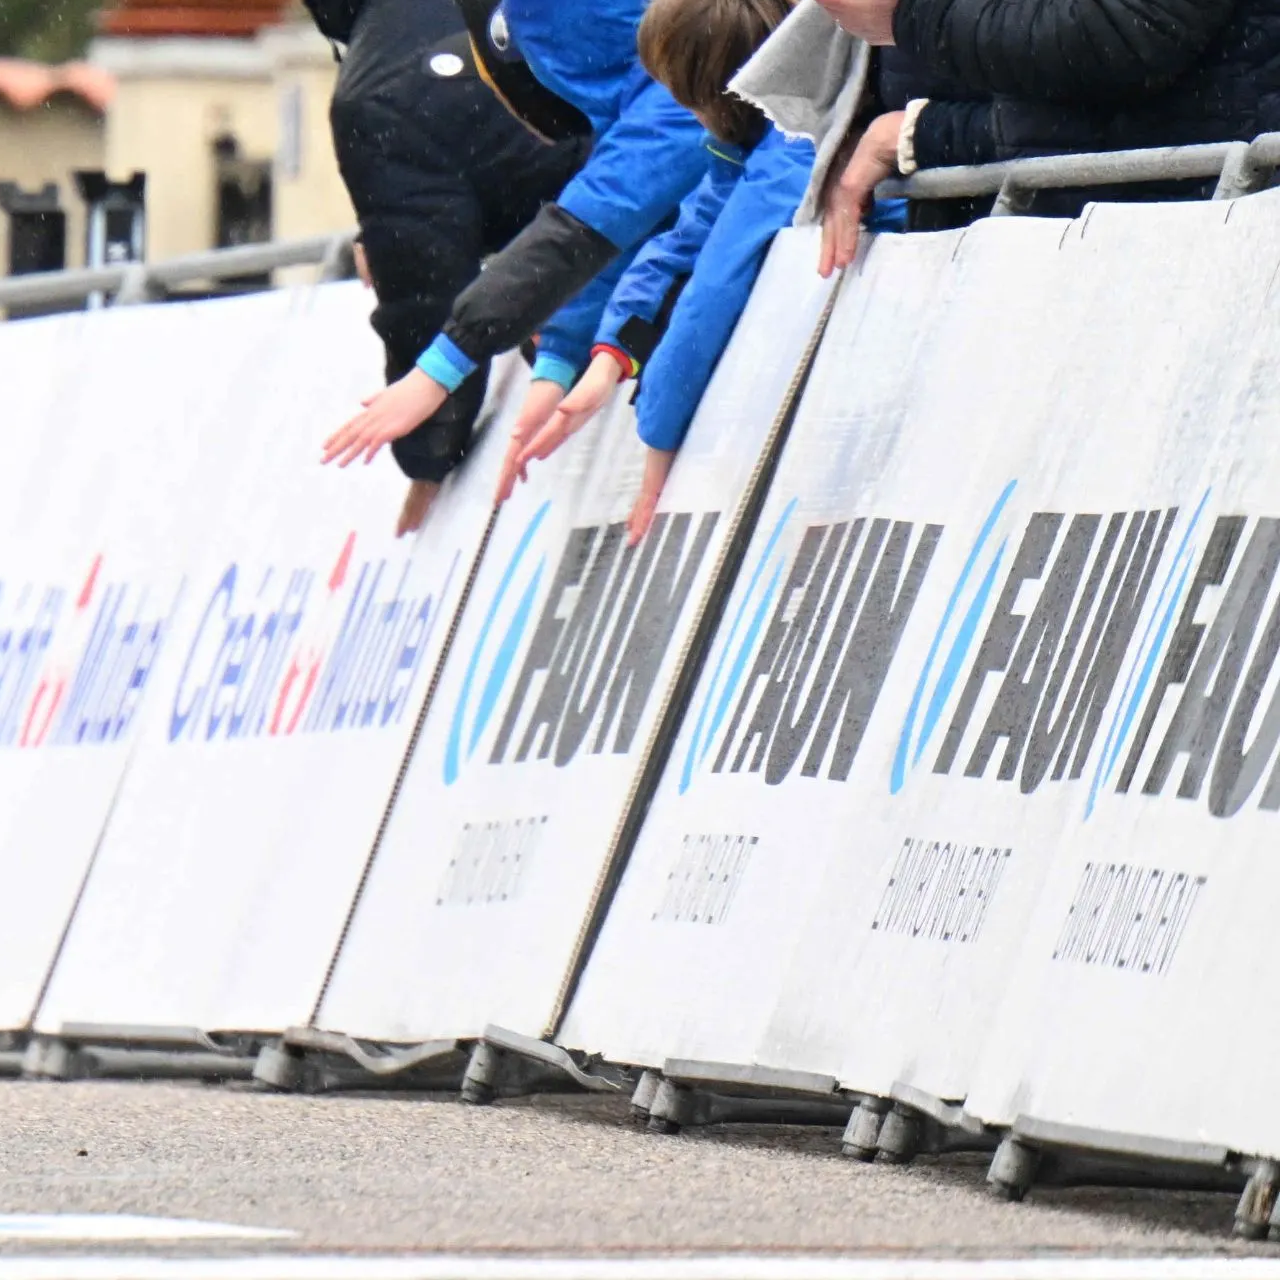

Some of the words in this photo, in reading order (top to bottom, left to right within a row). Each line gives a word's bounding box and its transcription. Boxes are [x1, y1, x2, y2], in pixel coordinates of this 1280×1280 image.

[487, 511, 722, 769] FAUN
[711, 516, 946, 787] FAUN
[931, 506, 1180, 795] FAUN
[1114, 514, 1280, 819] FAU
